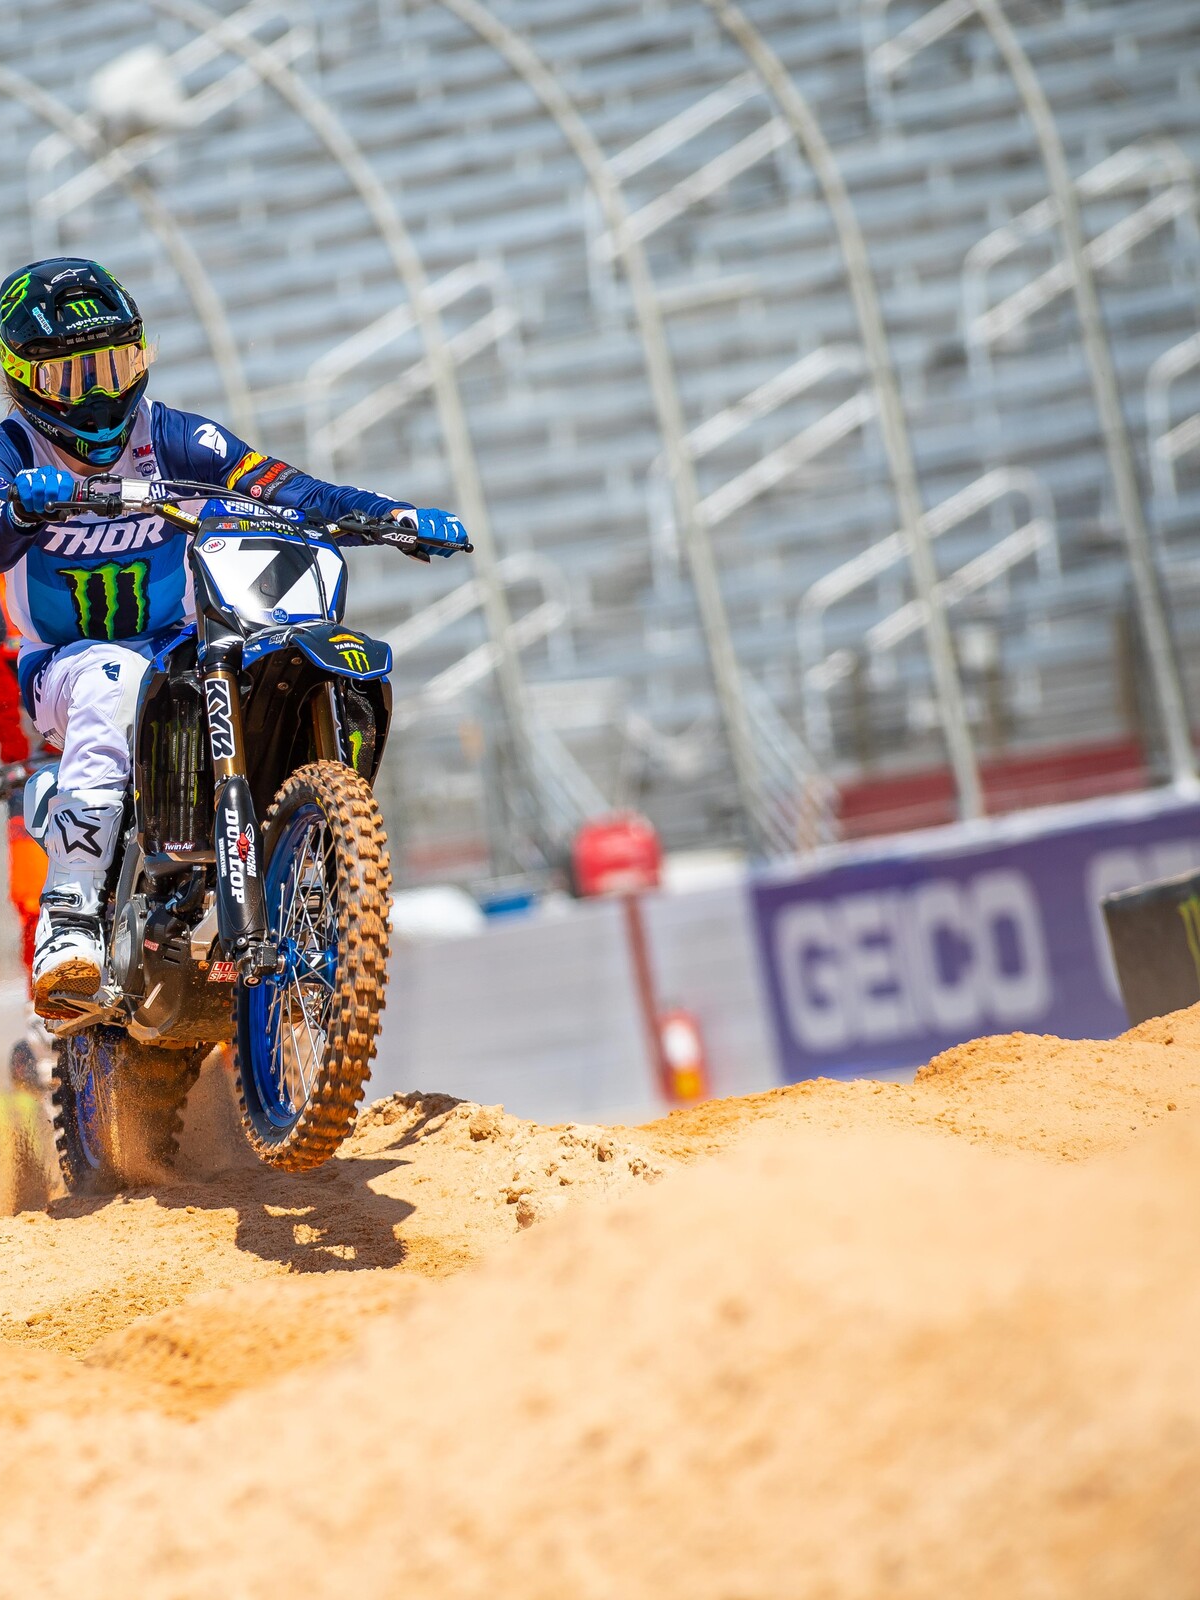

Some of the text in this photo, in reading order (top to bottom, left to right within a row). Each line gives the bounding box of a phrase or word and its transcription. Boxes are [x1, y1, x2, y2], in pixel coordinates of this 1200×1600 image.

[66, 316, 121, 330] MONSTER
[255, 462, 287, 486] YAMAH
[43, 514, 165, 556] THOR
[250, 519, 300, 532] MONSTE
[382, 532, 417, 543] ARC
[205, 678, 236, 761] KYB
[164, 842, 194, 851] Twin Air
[224, 808, 245, 904] DUNLOP
[774, 868, 1050, 1052] GEICO
